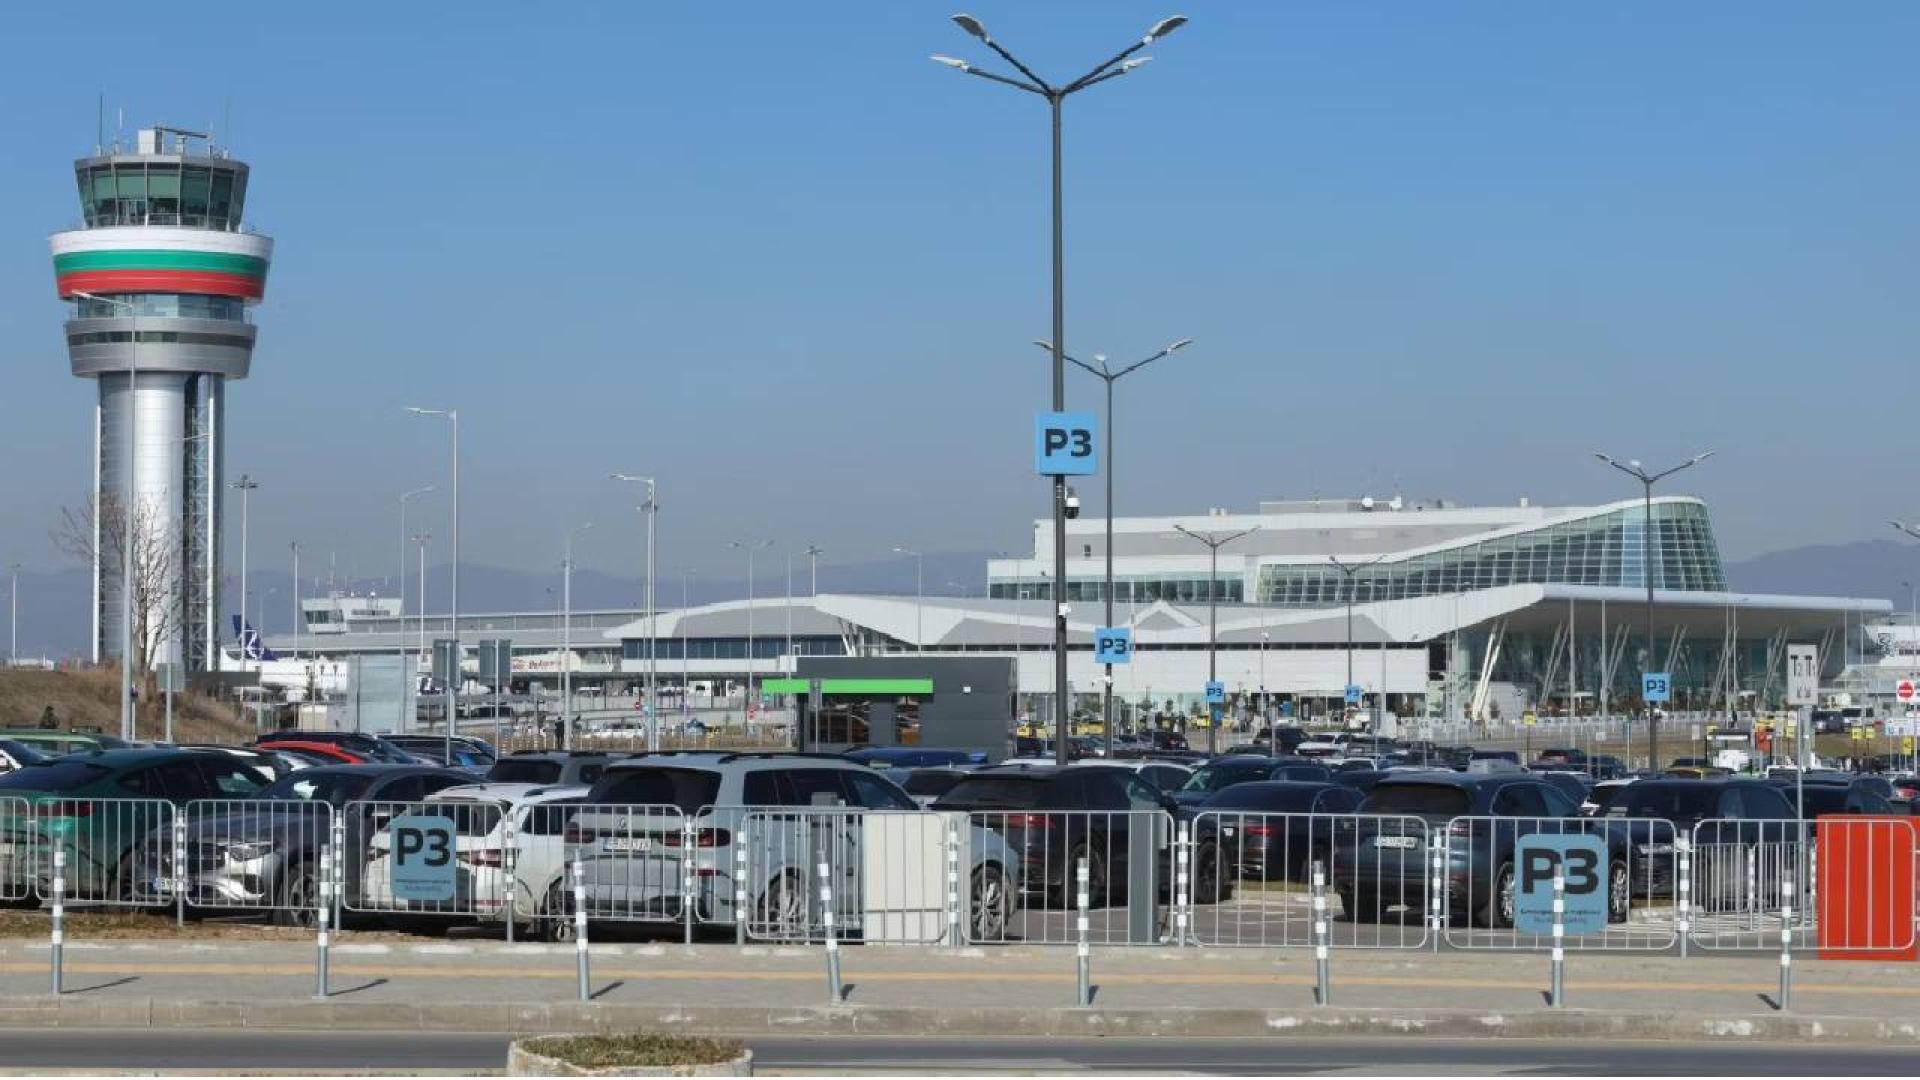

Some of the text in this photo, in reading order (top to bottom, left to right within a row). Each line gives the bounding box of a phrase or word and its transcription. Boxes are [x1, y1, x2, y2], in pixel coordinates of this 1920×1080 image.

[1045, 428, 1092, 457] P3
[1099, 637, 1126, 655] P3
[1207, 687, 1222, 697] P3
[1646, 679, 1665, 693] P3
[397, 827, 450, 866] P3
[1522, 848, 1599, 895] P3
